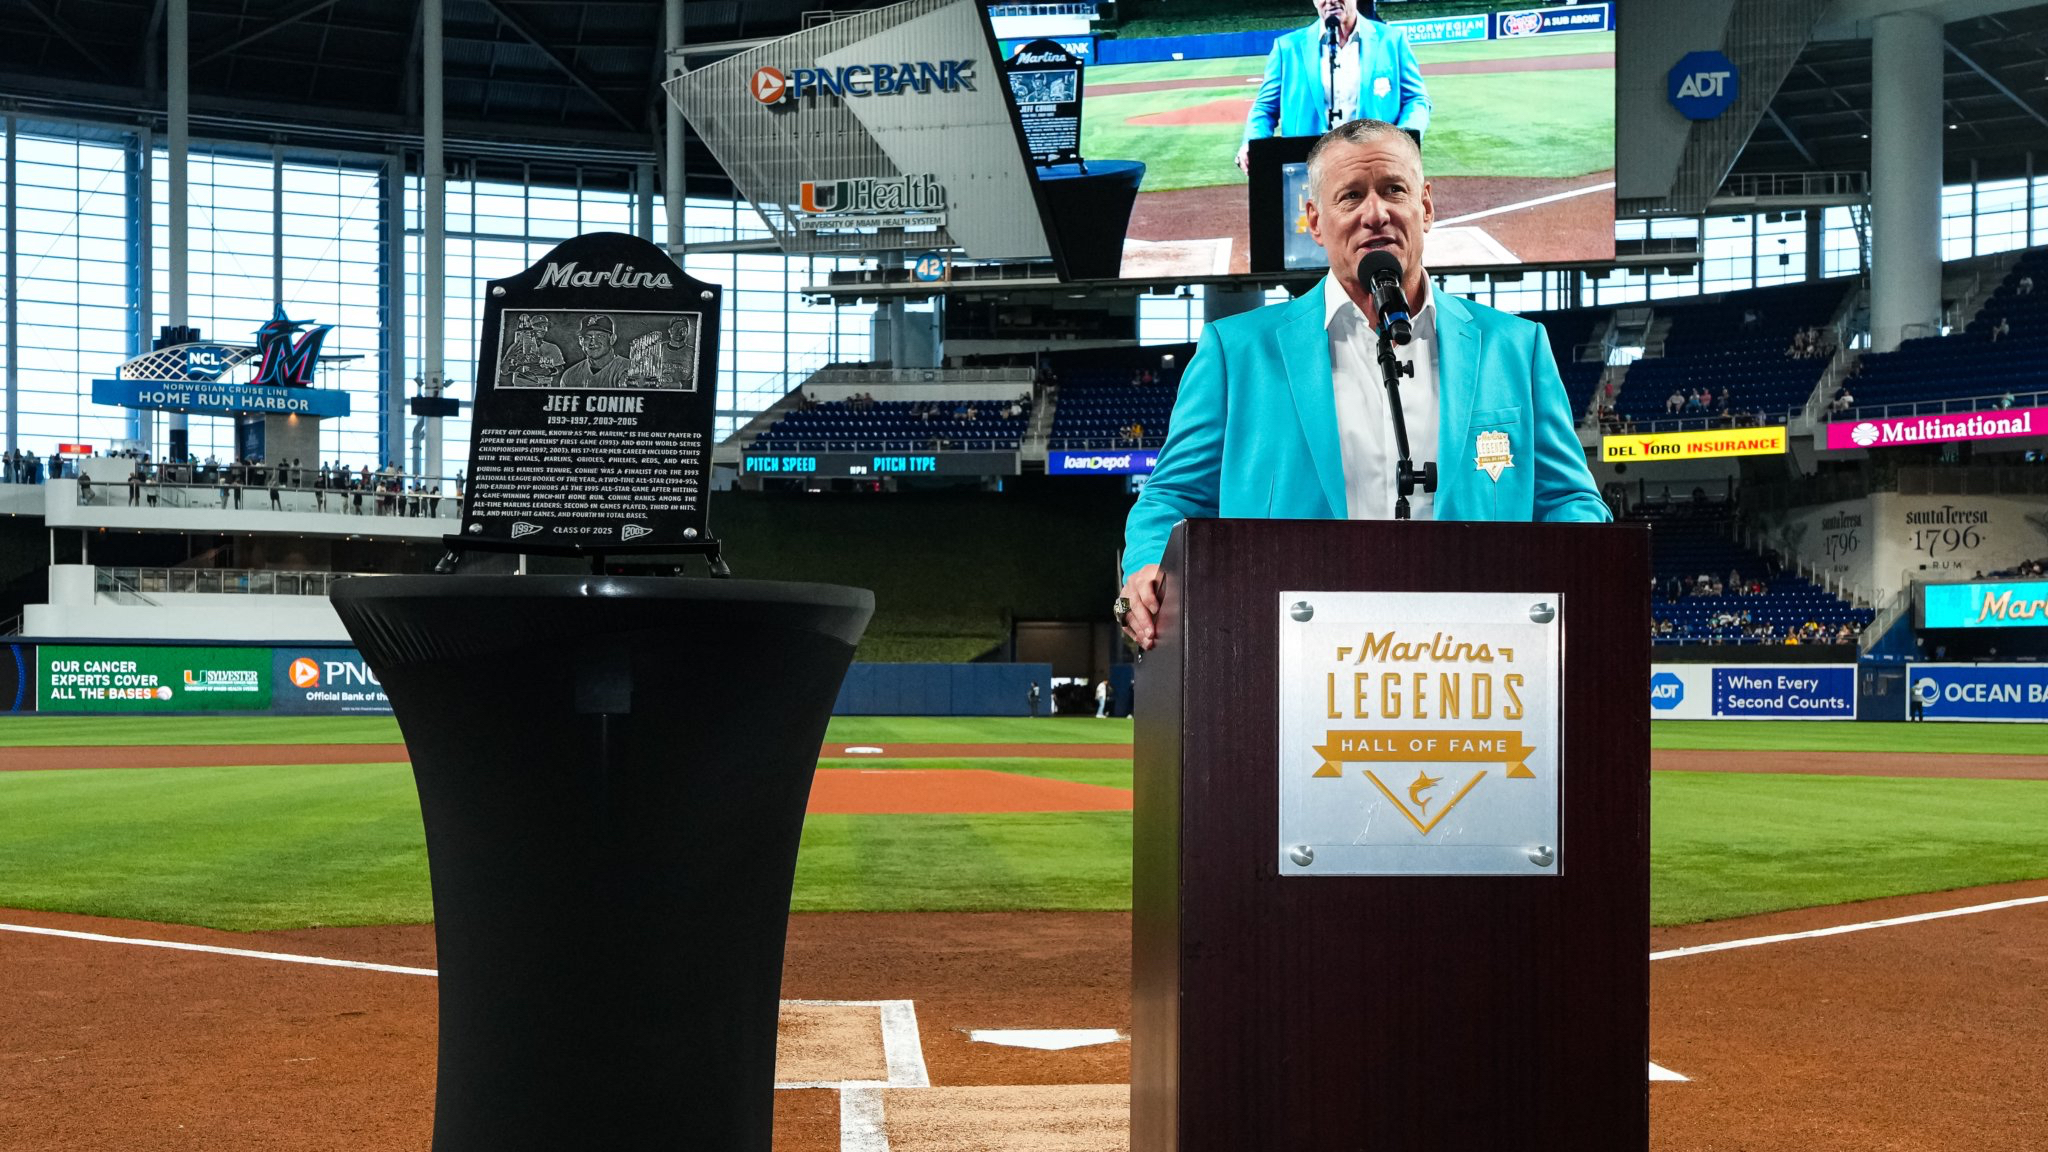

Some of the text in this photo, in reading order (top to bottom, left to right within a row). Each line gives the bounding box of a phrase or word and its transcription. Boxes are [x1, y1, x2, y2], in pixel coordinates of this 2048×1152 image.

[1408, 20, 1484, 33] NORWEGIAN
[1544, 18, 1551, 26] A
[1552, 16, 1570, 26] SUB
[1571, 14, 1600, 24] ABOVE
[1016, 52, 1066, 65] Marlins
[1676, 72, 1730, 98] ADT
[802, 220, 844, 229] UNIVERSITY
[856, 219, 880, 227] MIAMI
[883, 217, 910, 226] HEALTH
[912, 216, 942, 225] SYSTEM
[918, 258, 940, 276] 42
[534, 262, 673, 290] Marlins
[189, 352, 219, 365] NCL
[163, 383, 226, 393] NORWEGIAN
[228, 386, 264, 395] CRUISE
[139, 391, 309, 411] HOME RUN HARBOR
[543, 395, 644, 413] JEFF CONINE
[1881, 414, 2031, 443] Multinational
[1608, 437, 1780, 457] DEL TORO INSURANCE
[747, 457, 936, 474] PITCH SPEED MPH PITCH TYPE
[1064, 455, 1131, 471] loanDepot
[515, 524, 533, 534] 1997
[625, 527, 644, 537] 2003
[1354, 631, 1496, 665] Marlins
[51, 661, 136, 673] OUR CANCER
[51, 674, 158, 686] EXPERTS COVER
[208, 671, 258, 681] SYLVESTER
[1652, 684, 1679, 698] ADT
[1728, 676, 1819, 694] When Every
[51, 687, 151, 699] ALL THE BASES
[306, 692, 340, 701] Official
[342, 692, 364, 700] Bank
[366, 692, 375, 700] of
[1327, 672, 1524, 720] LEGENDS
[1945, 684, 2021, 702] OCEAN
[1728, 694, 1850, 709] Second Counts.
[1342, 739, 1507, 753] HALL OF FAME
